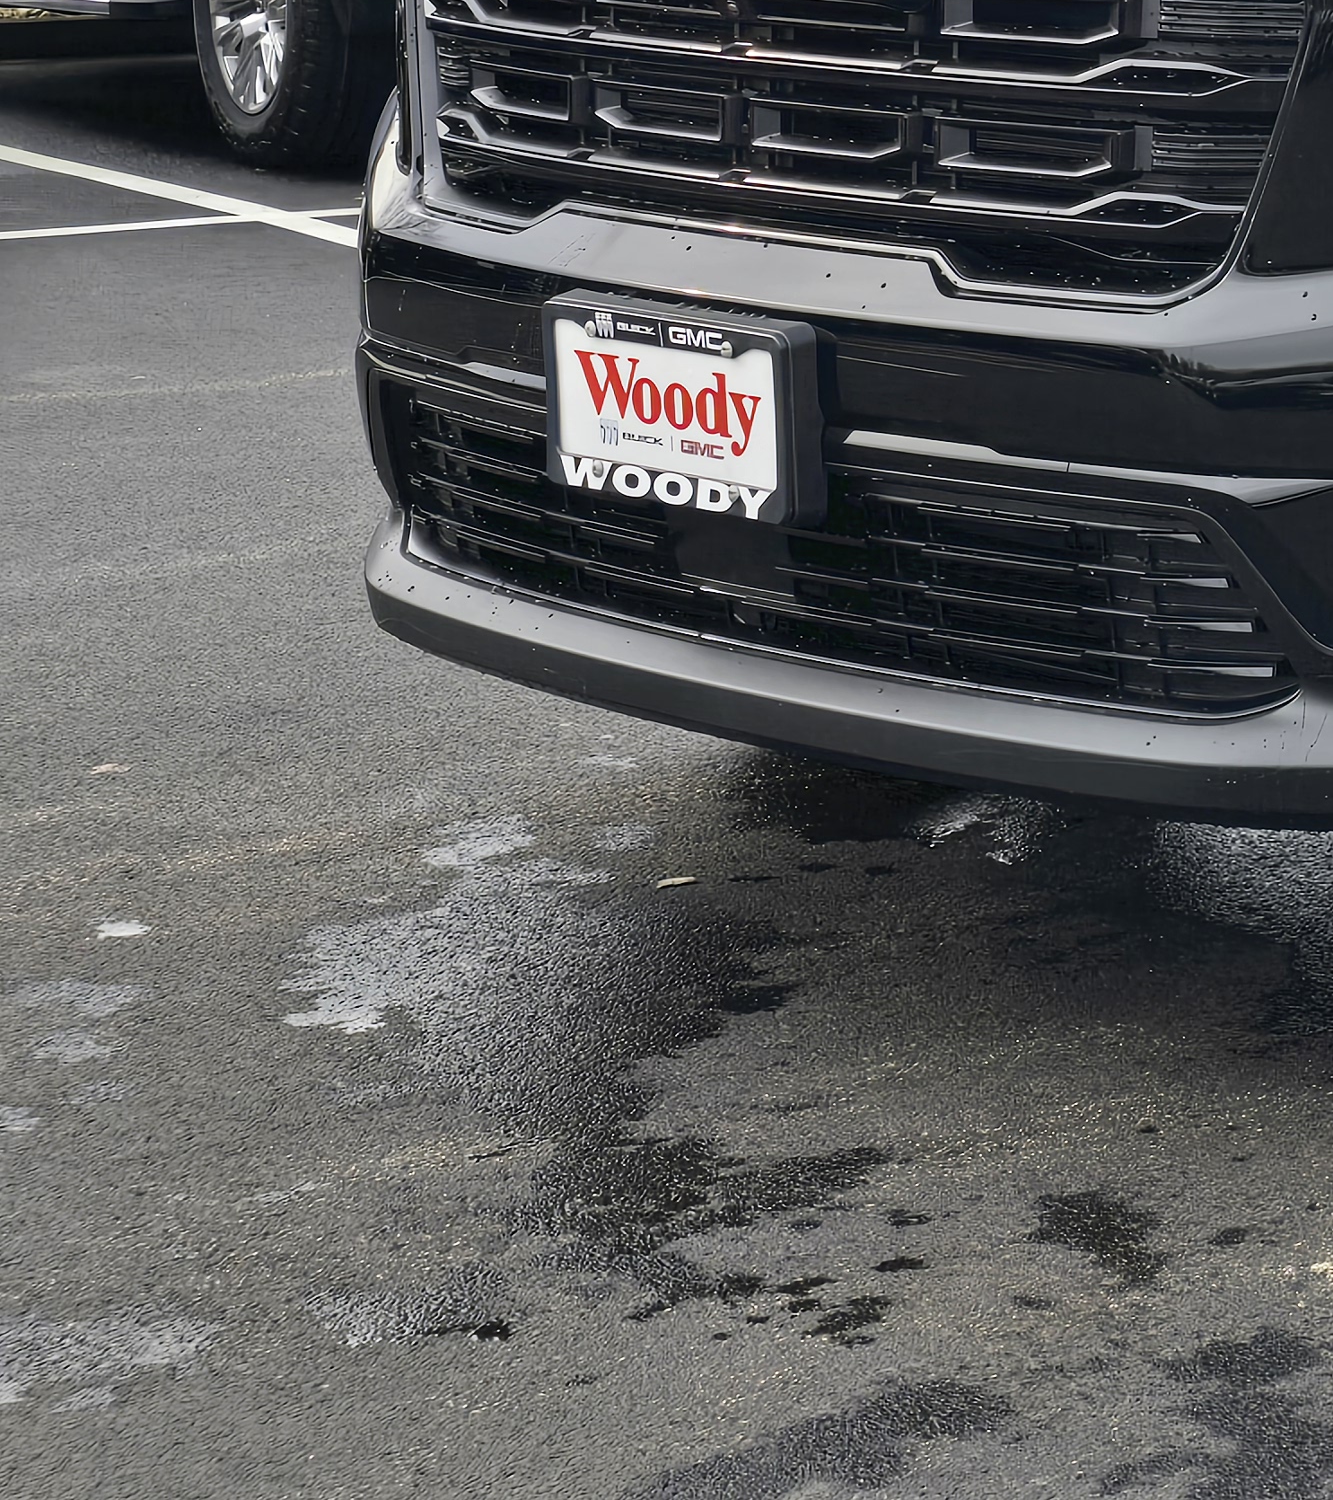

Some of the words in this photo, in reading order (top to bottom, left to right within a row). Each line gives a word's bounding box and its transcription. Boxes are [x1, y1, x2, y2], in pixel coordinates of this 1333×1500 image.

[616, 320, 657, 336] BUICK
[668, 326, 723, 351] GMC
[573, 349, 762, 457] Woody
[622, 431, 664, 447] BUICK
[680, 439, 725, 461] GMC
[559, 453, 775, 521] WOODY
